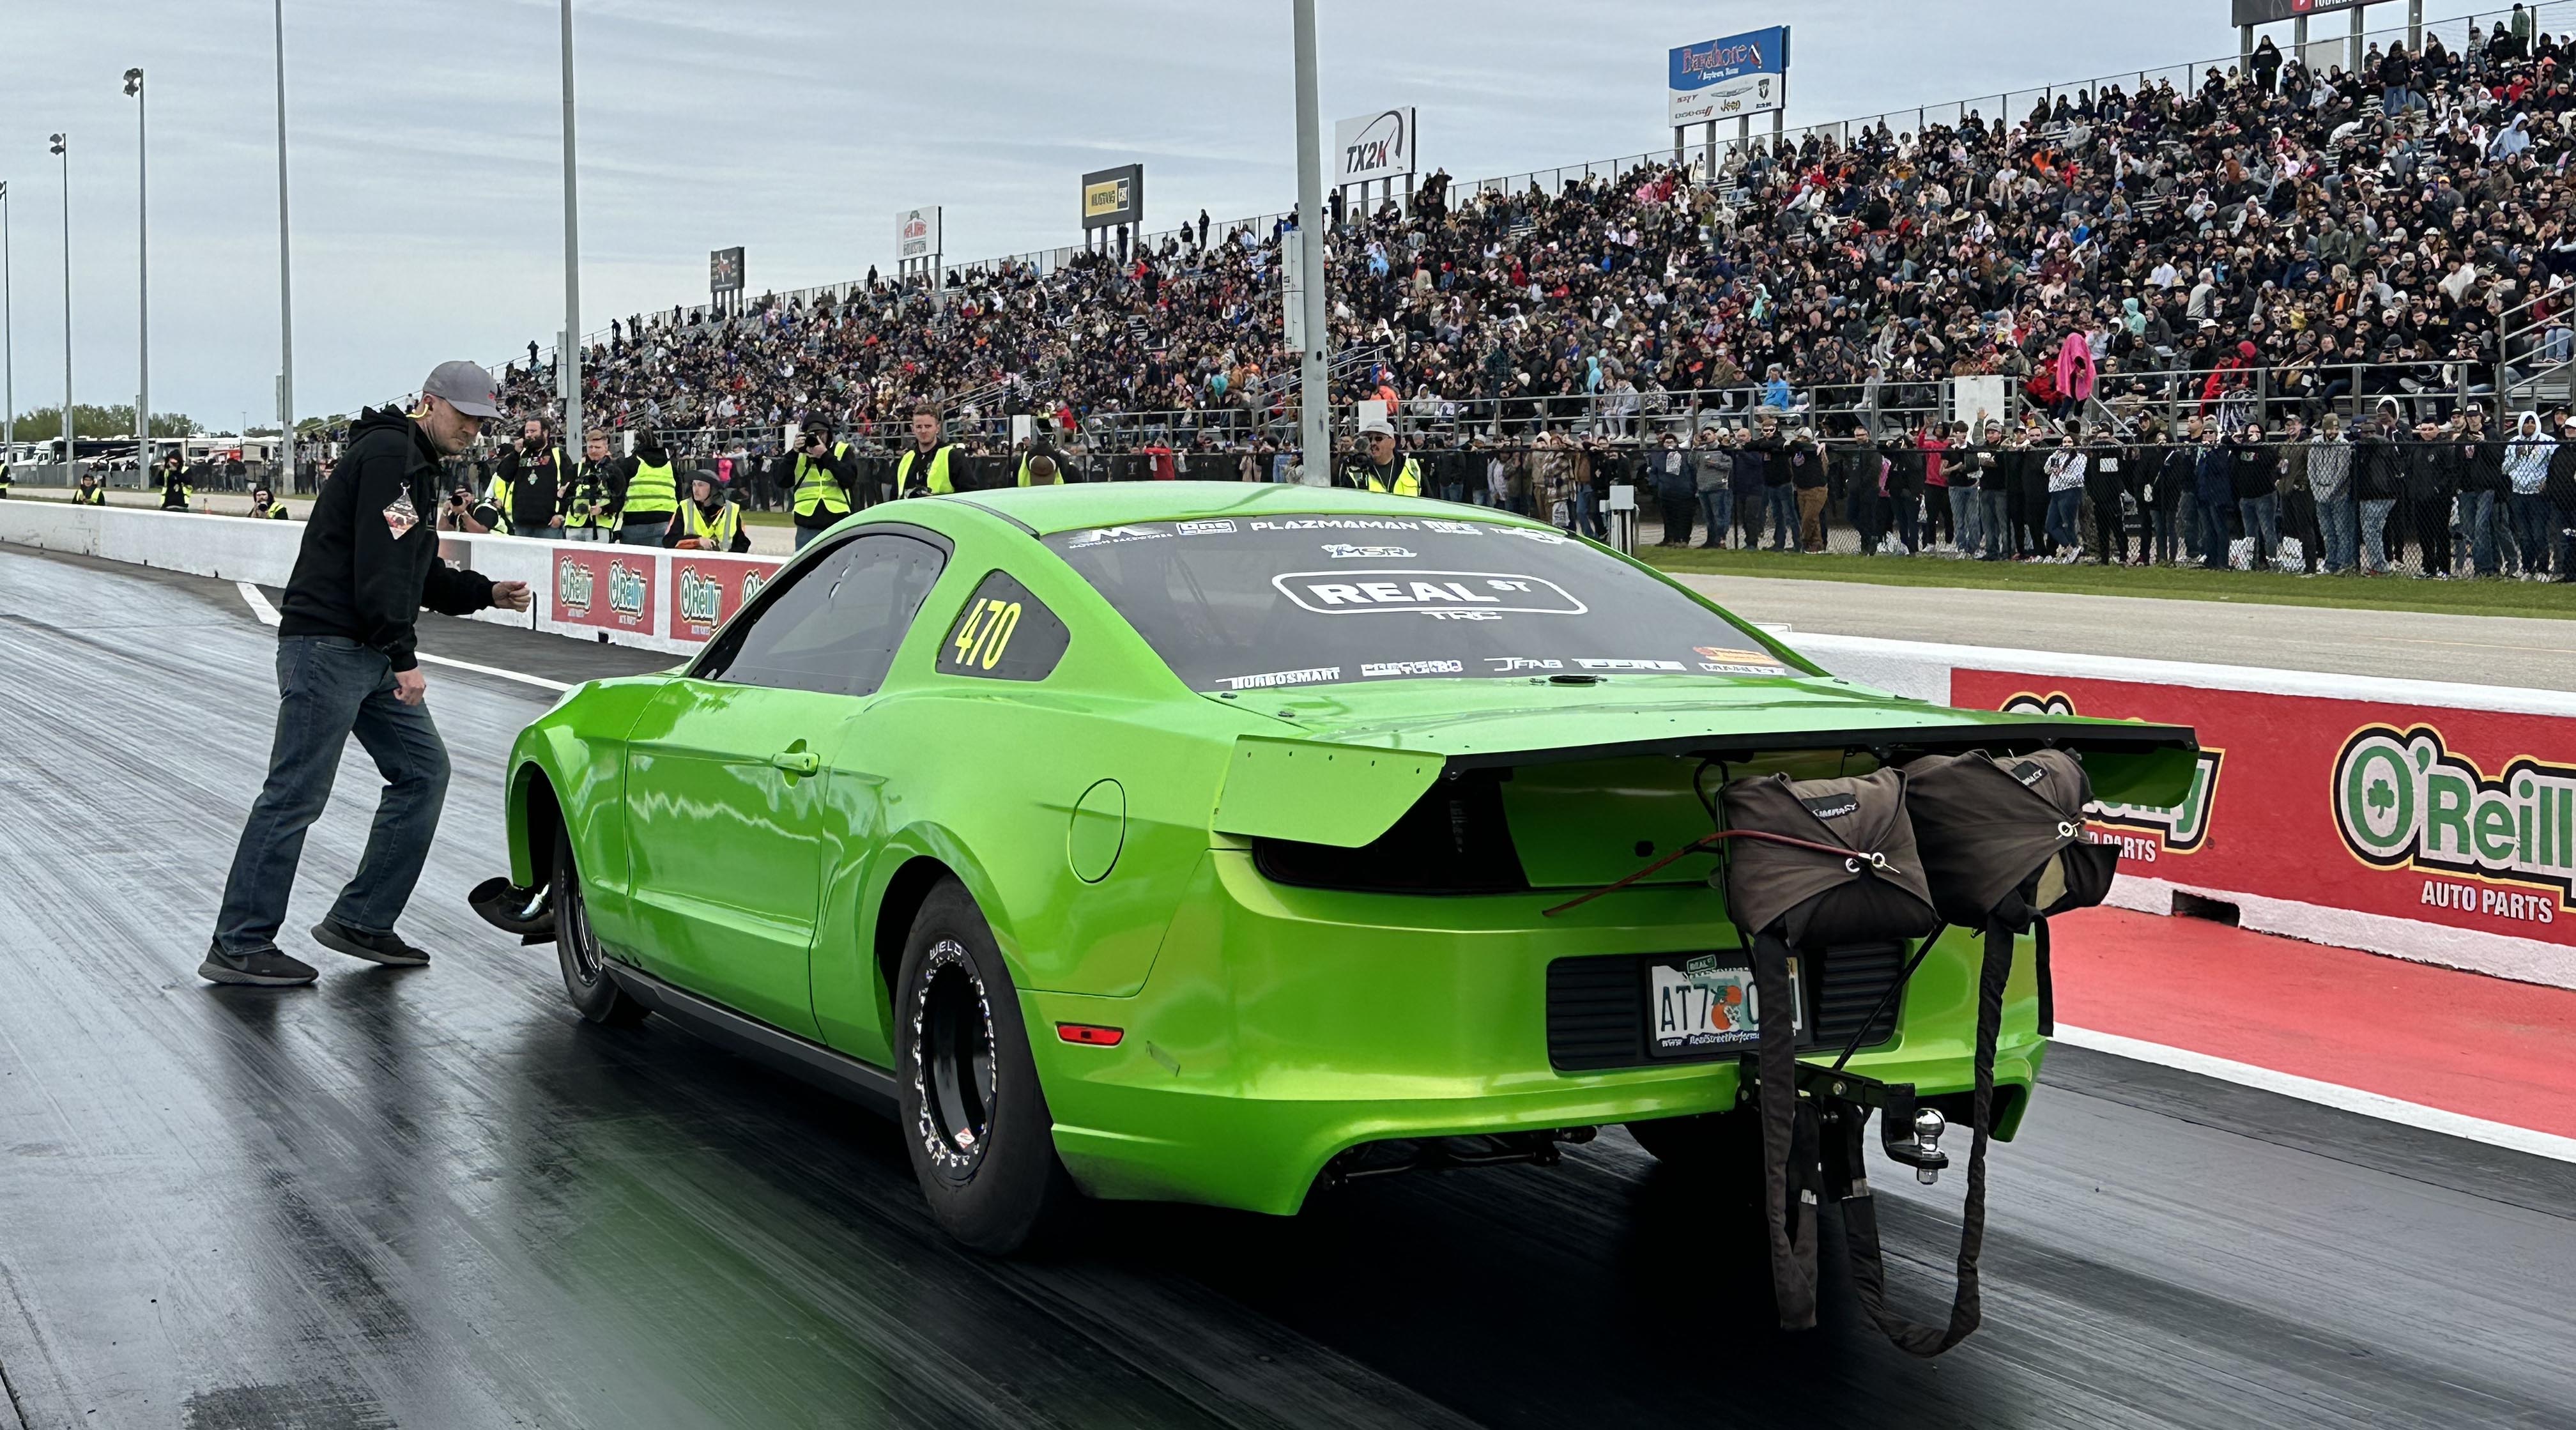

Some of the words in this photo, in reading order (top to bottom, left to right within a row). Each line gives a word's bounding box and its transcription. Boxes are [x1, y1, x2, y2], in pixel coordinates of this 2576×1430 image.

[1721, 98, 1741, 112] Jeep
[1346, 140, 1388, 174] TX2K
[1250, 520, 1420, 531] PLAZMAMAN
[681, 570, 721, 626] O'Reilly
[1307, 582, 1501, 604] REAL
[1486, 580, 1532, 592] ST
[954, 598, 1022, 670] 470
[1215, 666, 1340, 689] TURBOSMART
[2347, 745, 2576, 869] O'Reill
[2421, 880, 2477, 912] AUTO
[2482, 888, 2554, 923] PARTS
[930, 940, 962, 960] WELD
